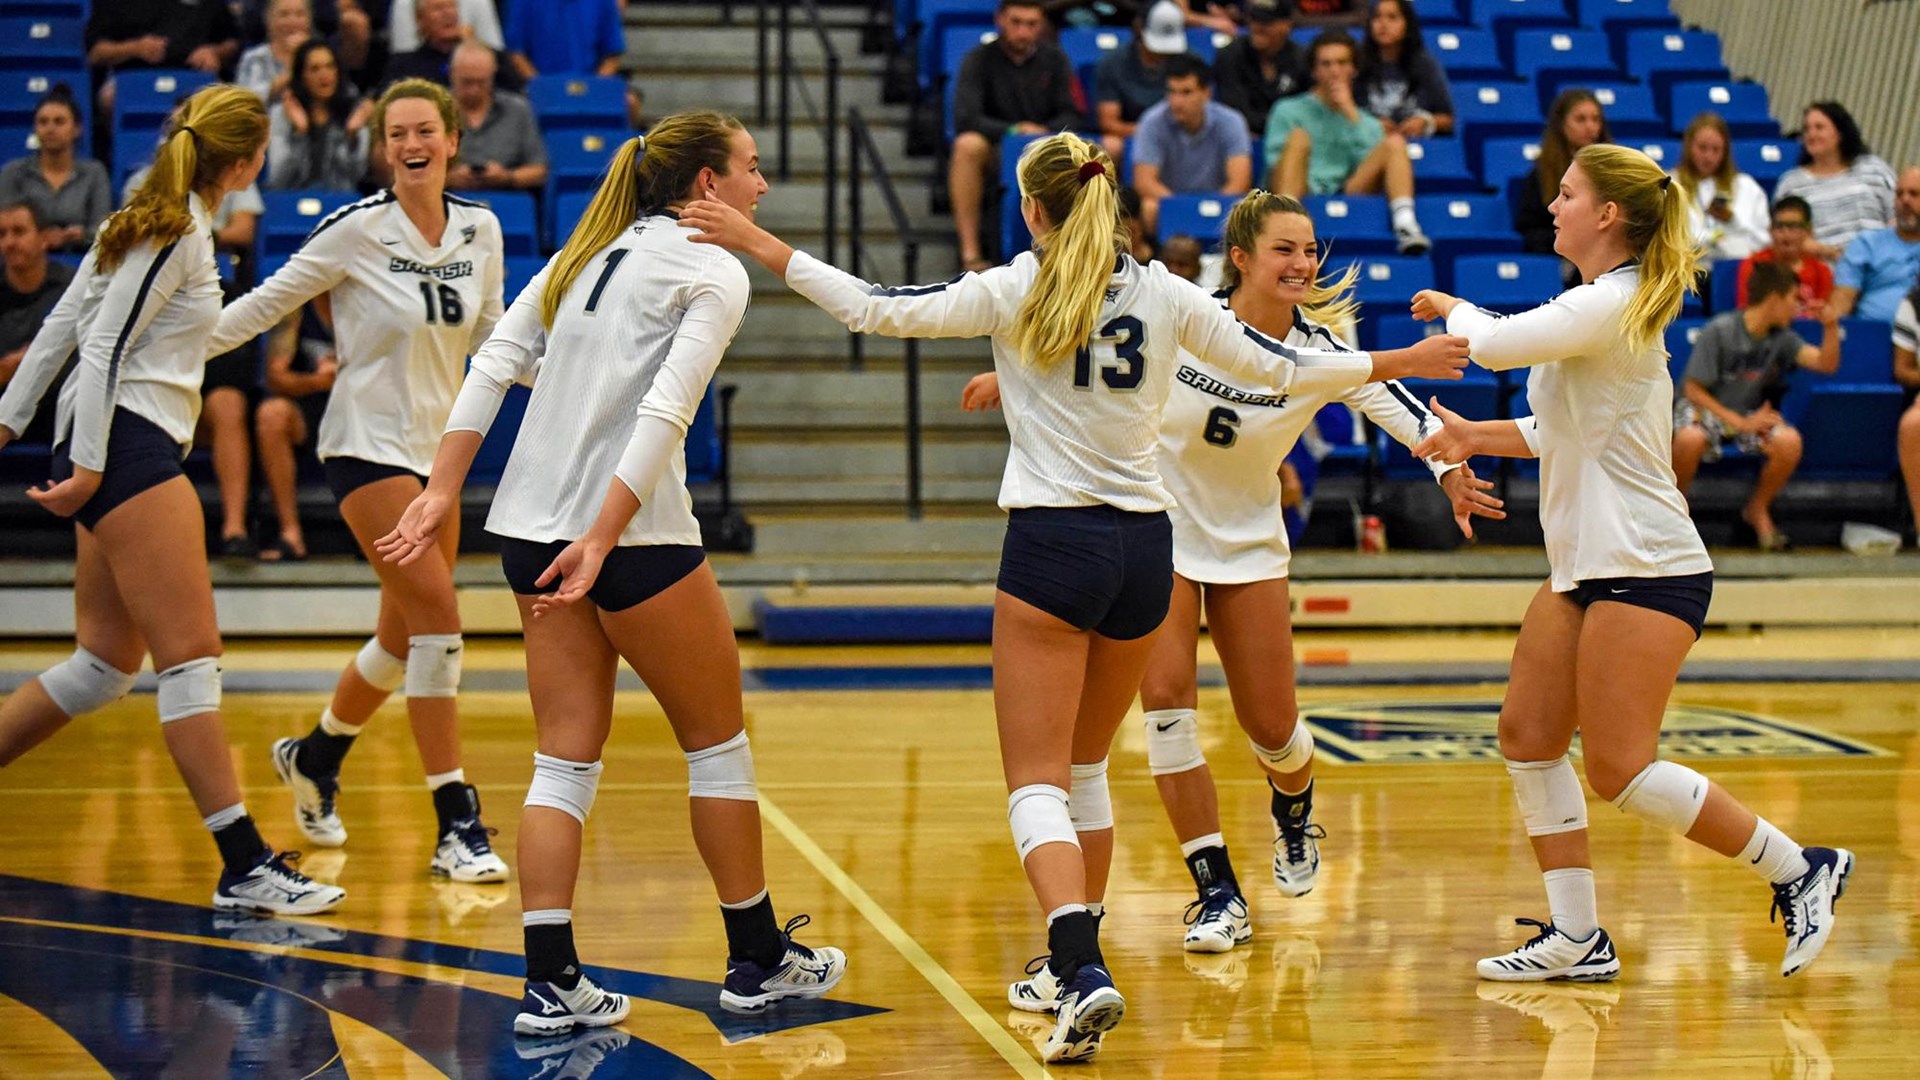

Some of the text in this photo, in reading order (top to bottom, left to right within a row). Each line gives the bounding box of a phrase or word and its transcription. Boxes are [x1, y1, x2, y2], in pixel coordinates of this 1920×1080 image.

[389, 257, 473, 281] SAFISH
[583, 248, 632, 317] 1
[419, 281, 465, 327] 16
[1072, 315, 1148, 393] 13
[1203, 405, 1241, 449] 6
